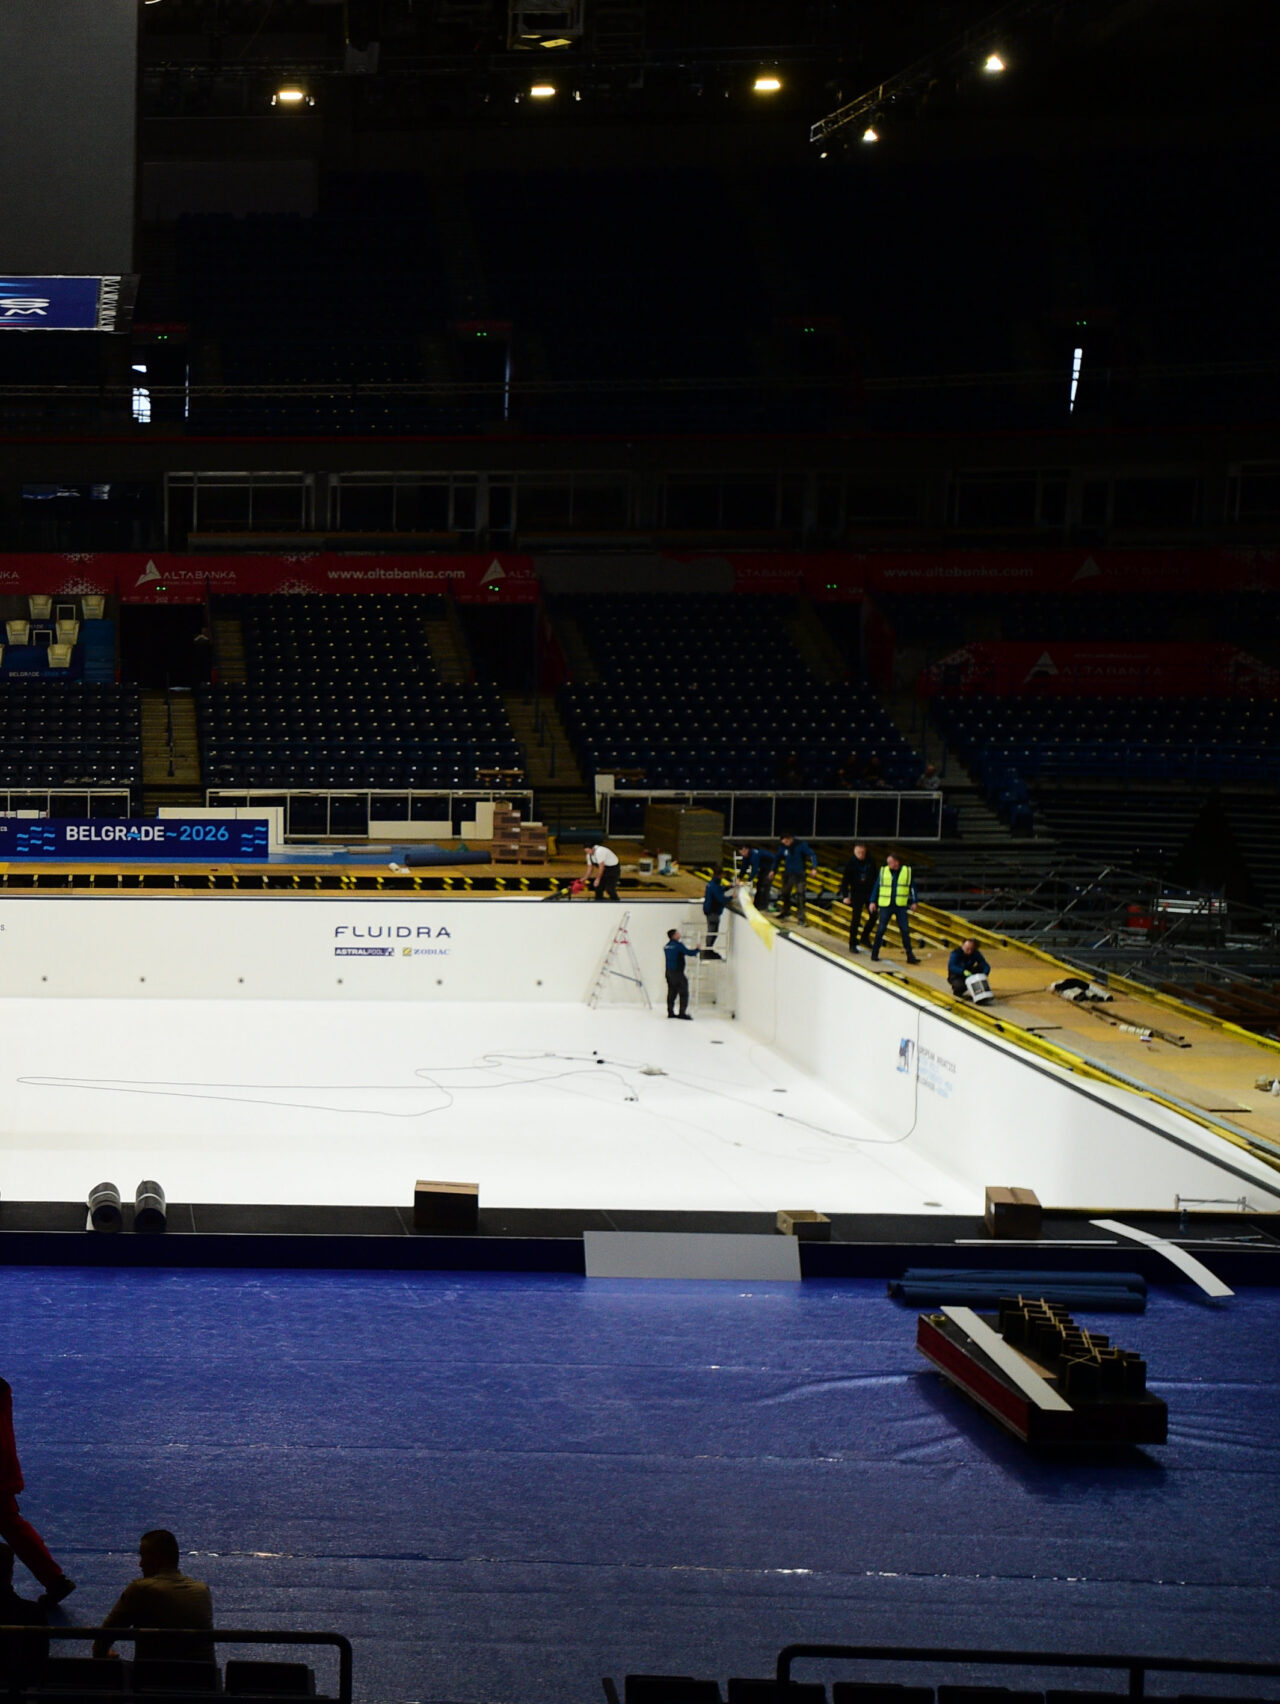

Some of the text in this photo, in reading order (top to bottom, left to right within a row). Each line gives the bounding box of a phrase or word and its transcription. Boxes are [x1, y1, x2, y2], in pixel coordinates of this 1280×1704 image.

[163, 571, 236, 579] ALTABANKA
[327, 568, 466, 580] www.altabanka.com
[736, 569, 804, 577] LTABANKA
[334, 926, 451, 938] FLUIDRA
